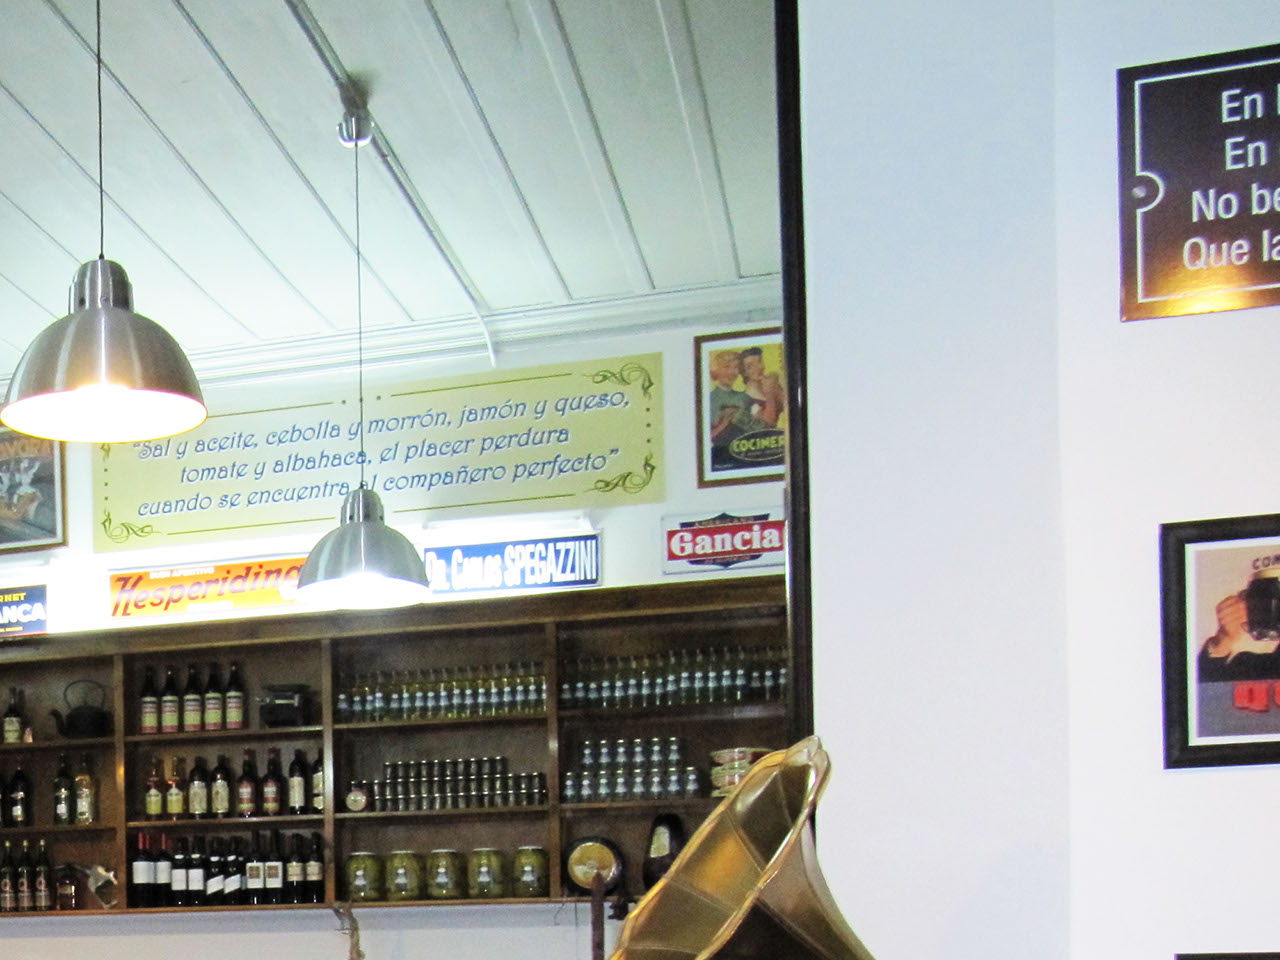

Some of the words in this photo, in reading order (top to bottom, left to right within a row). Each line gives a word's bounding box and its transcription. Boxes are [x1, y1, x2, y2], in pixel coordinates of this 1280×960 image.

[1221, 88, 1264, 123] En
[1225, 136, 1267, 170] En
[1191, 188, 1239, 222] No
[1182, 236, 1251, 271] Que
[176, 442, 187, 459] y
[194, 431, 258, 454] aceite,
[266, 419, 340, 446] cebolla
[348, 421, 361, 440] y
[368, 408, 452, 433] morrón,
[457, 399, 526, 428] jamón
[534, 401, 547, 420] y
[555, 391, 630, 415] queso,
[181, 462, 248, 483] tomate
[254, 461, 266, 481] y
[273, 450, 371, 475] albahaca,
[379, 442, 399, 464] el
[404, 437, 474, 463] placer
[479, 427, 569, 456] perdura
[733, 435, 784, 453] COCINER
[138, 493, 212, 517] cuando
[218, 492, 241, 509] se
[247, 480, 350, 507] encuentra
[383, 465, 507, 491] compañero
[670, 524, 782, 556] Gancia
[504, 539, 596, 586] SPEGAZZINI
